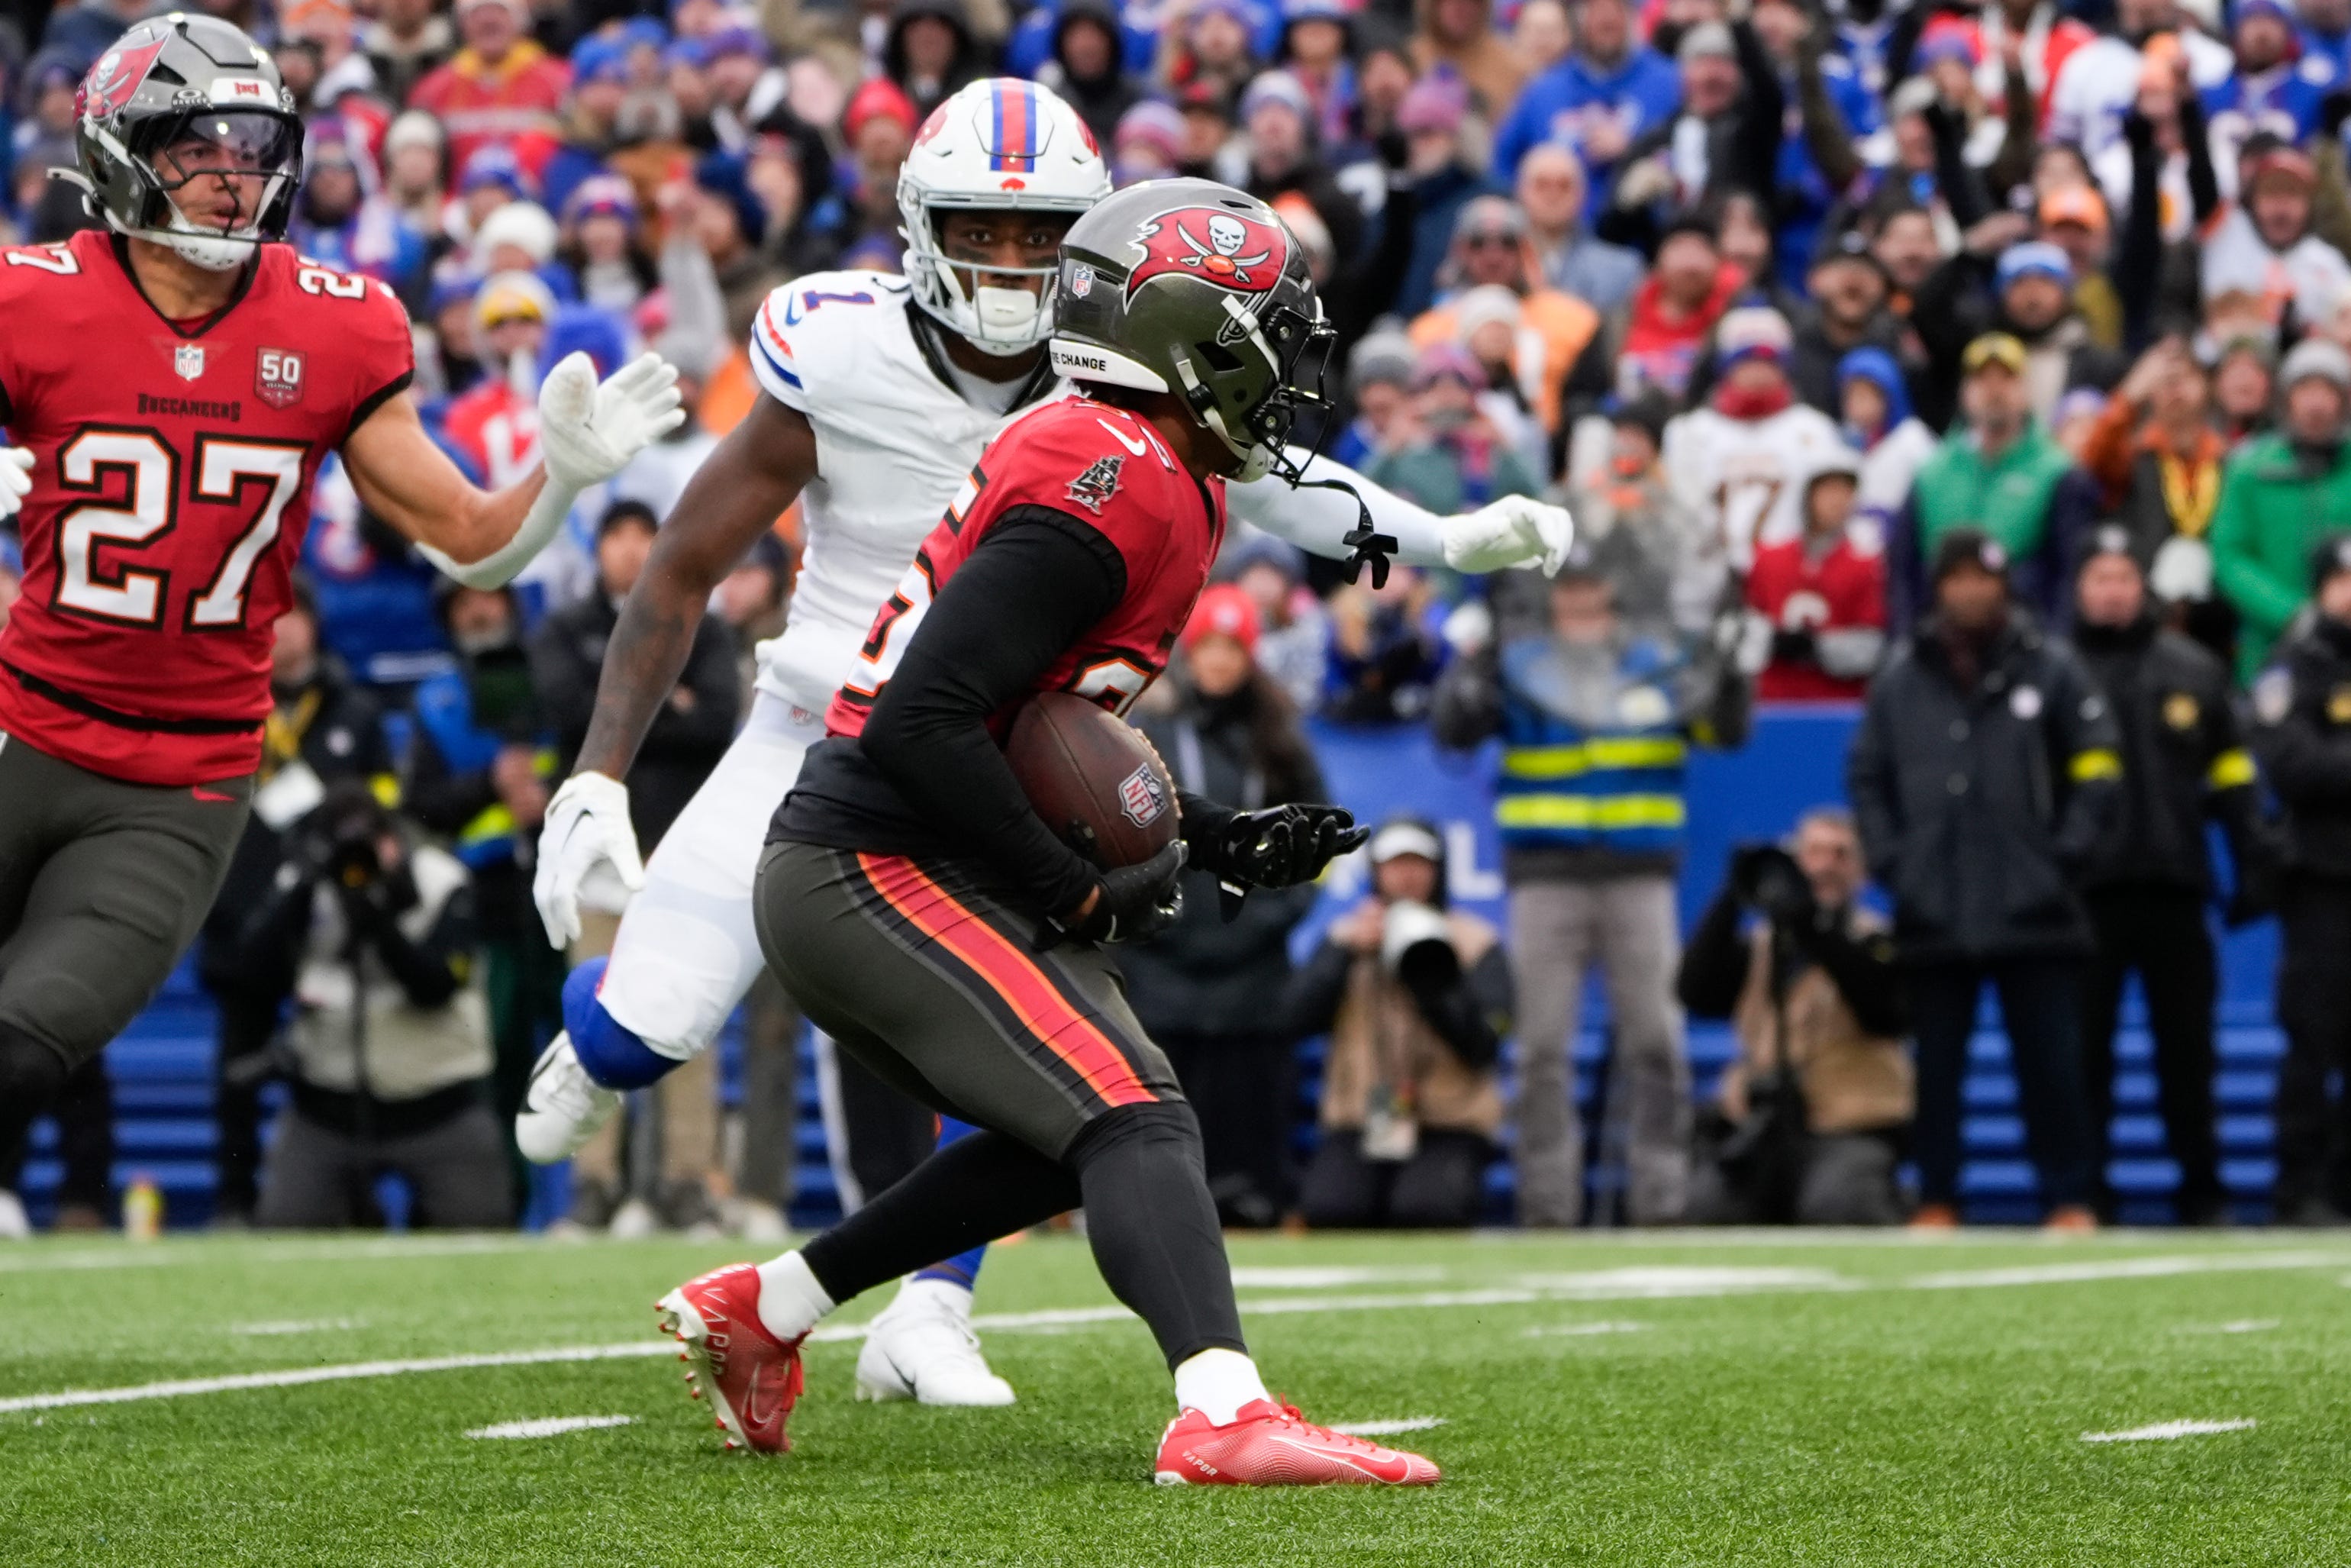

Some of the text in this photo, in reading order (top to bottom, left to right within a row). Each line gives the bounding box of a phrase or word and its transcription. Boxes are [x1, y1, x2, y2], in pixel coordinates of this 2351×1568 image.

[802, 289, 875, 312] 1
[261, 353, 300, 385] 50
[1061, 353, 1107, 372] CHANGE
[137, 393, 241, 422] BUCCANEERS
[50, 421, 313, 633] 27
[1125, 779, 1153, 821] NFL
[1182, 1450, 1217, 1477] VAPOR
